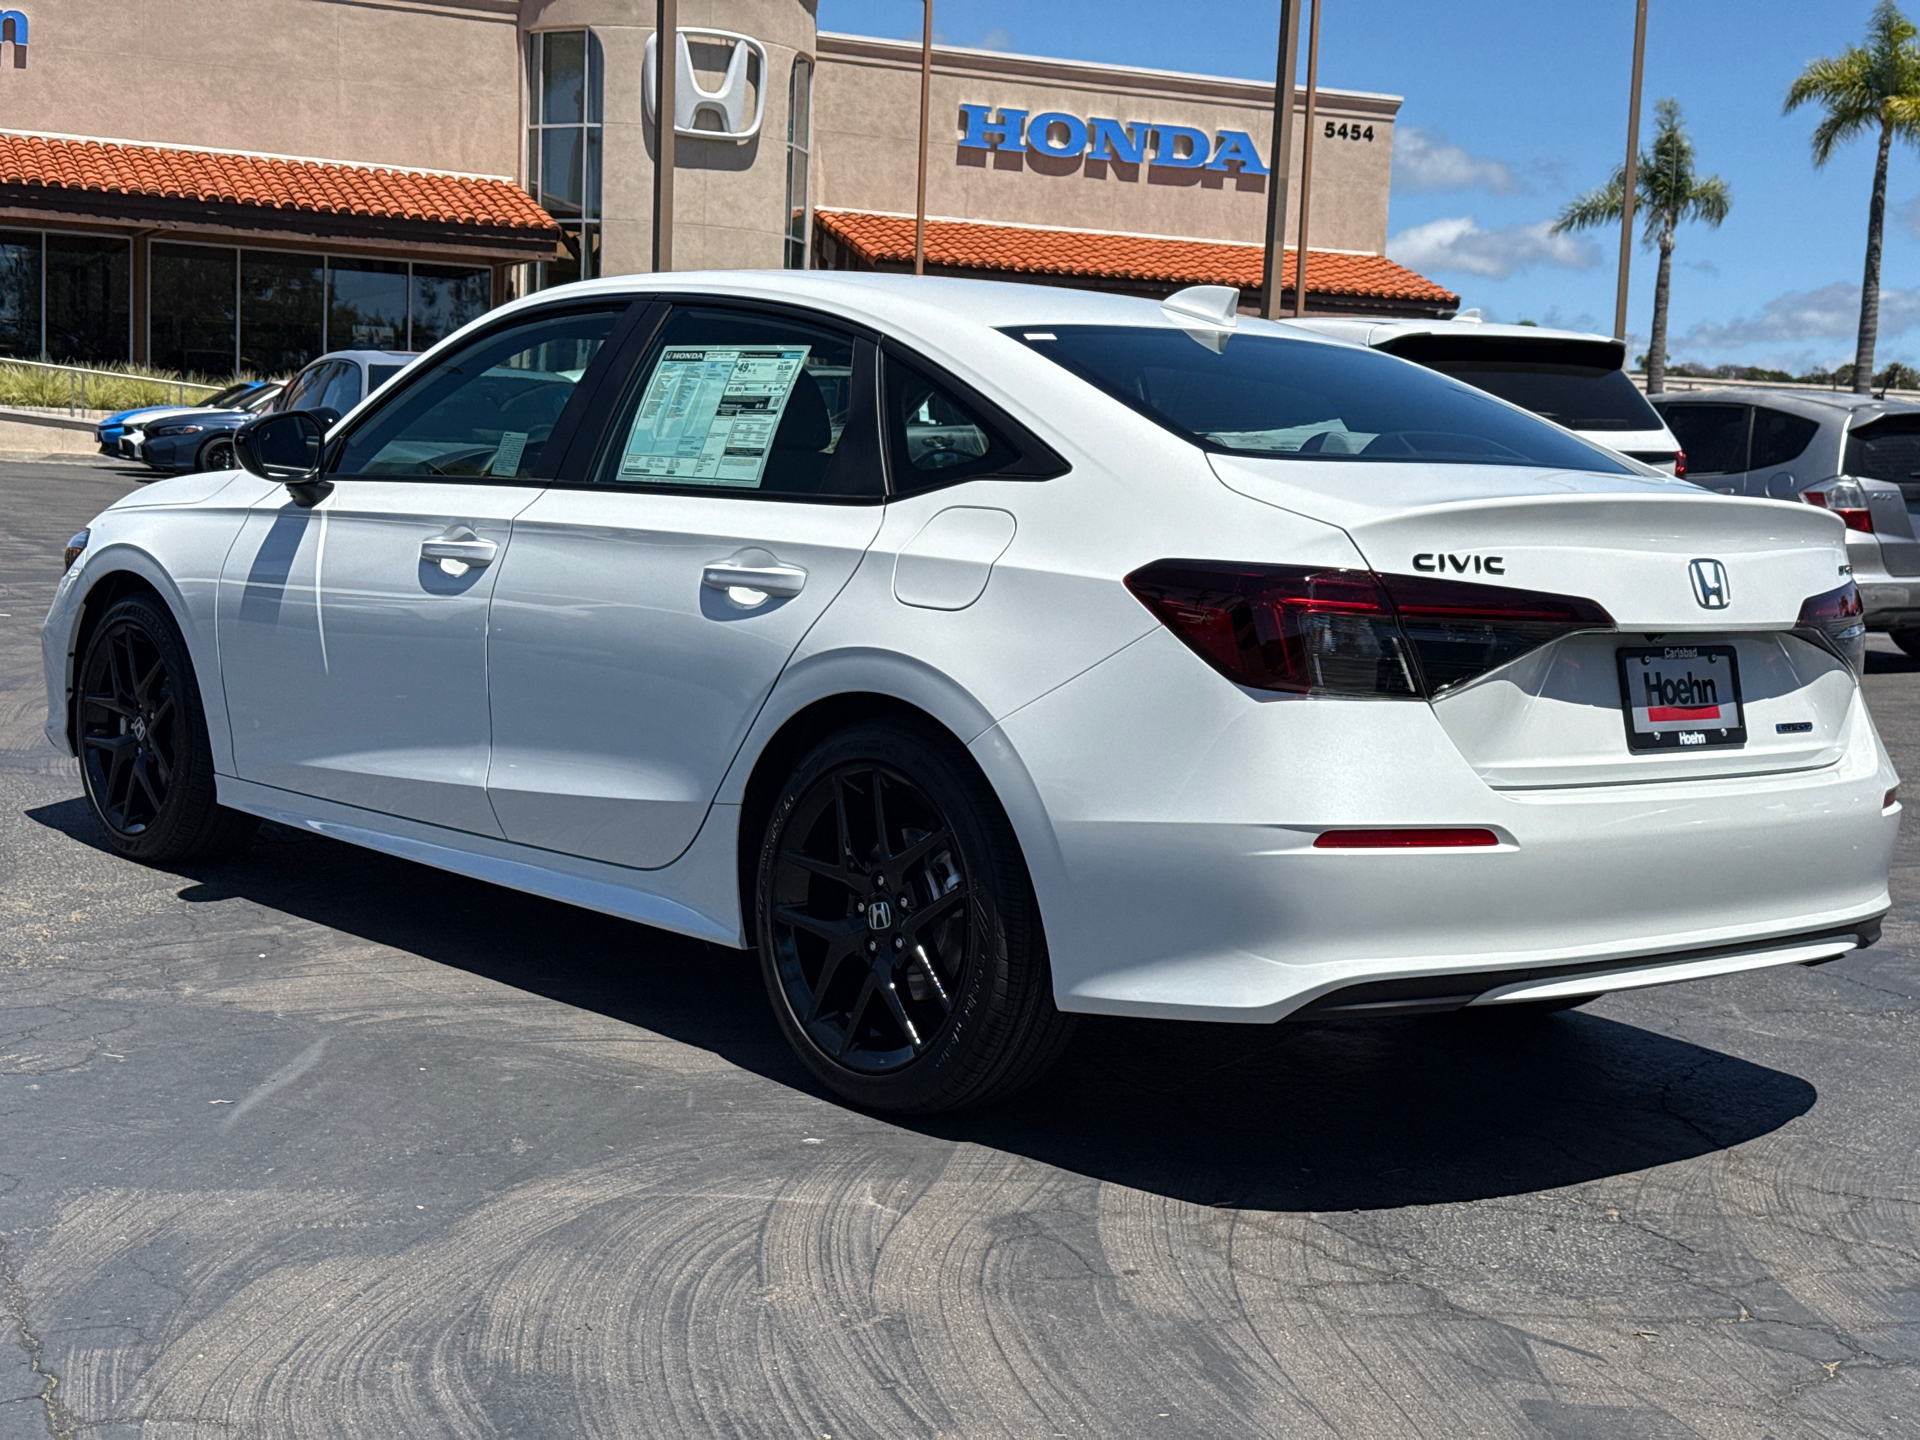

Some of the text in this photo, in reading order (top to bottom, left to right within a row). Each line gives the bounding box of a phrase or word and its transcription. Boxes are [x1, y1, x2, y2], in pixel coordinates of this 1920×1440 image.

[957, 102, 1270, 176] HONDA
[1323, 121, 1375, 143] 5454
[672, 352, 703, 360] HONDA
[738, 362, 750, 373] 49
[1412, 553, 1506, 576] CIVIC
[1664, 647, 1698, 659] Carlsbad
[1643, 671, 1719, 707] Hoehn
[1678, 731, 1707, 746] Hoehn
